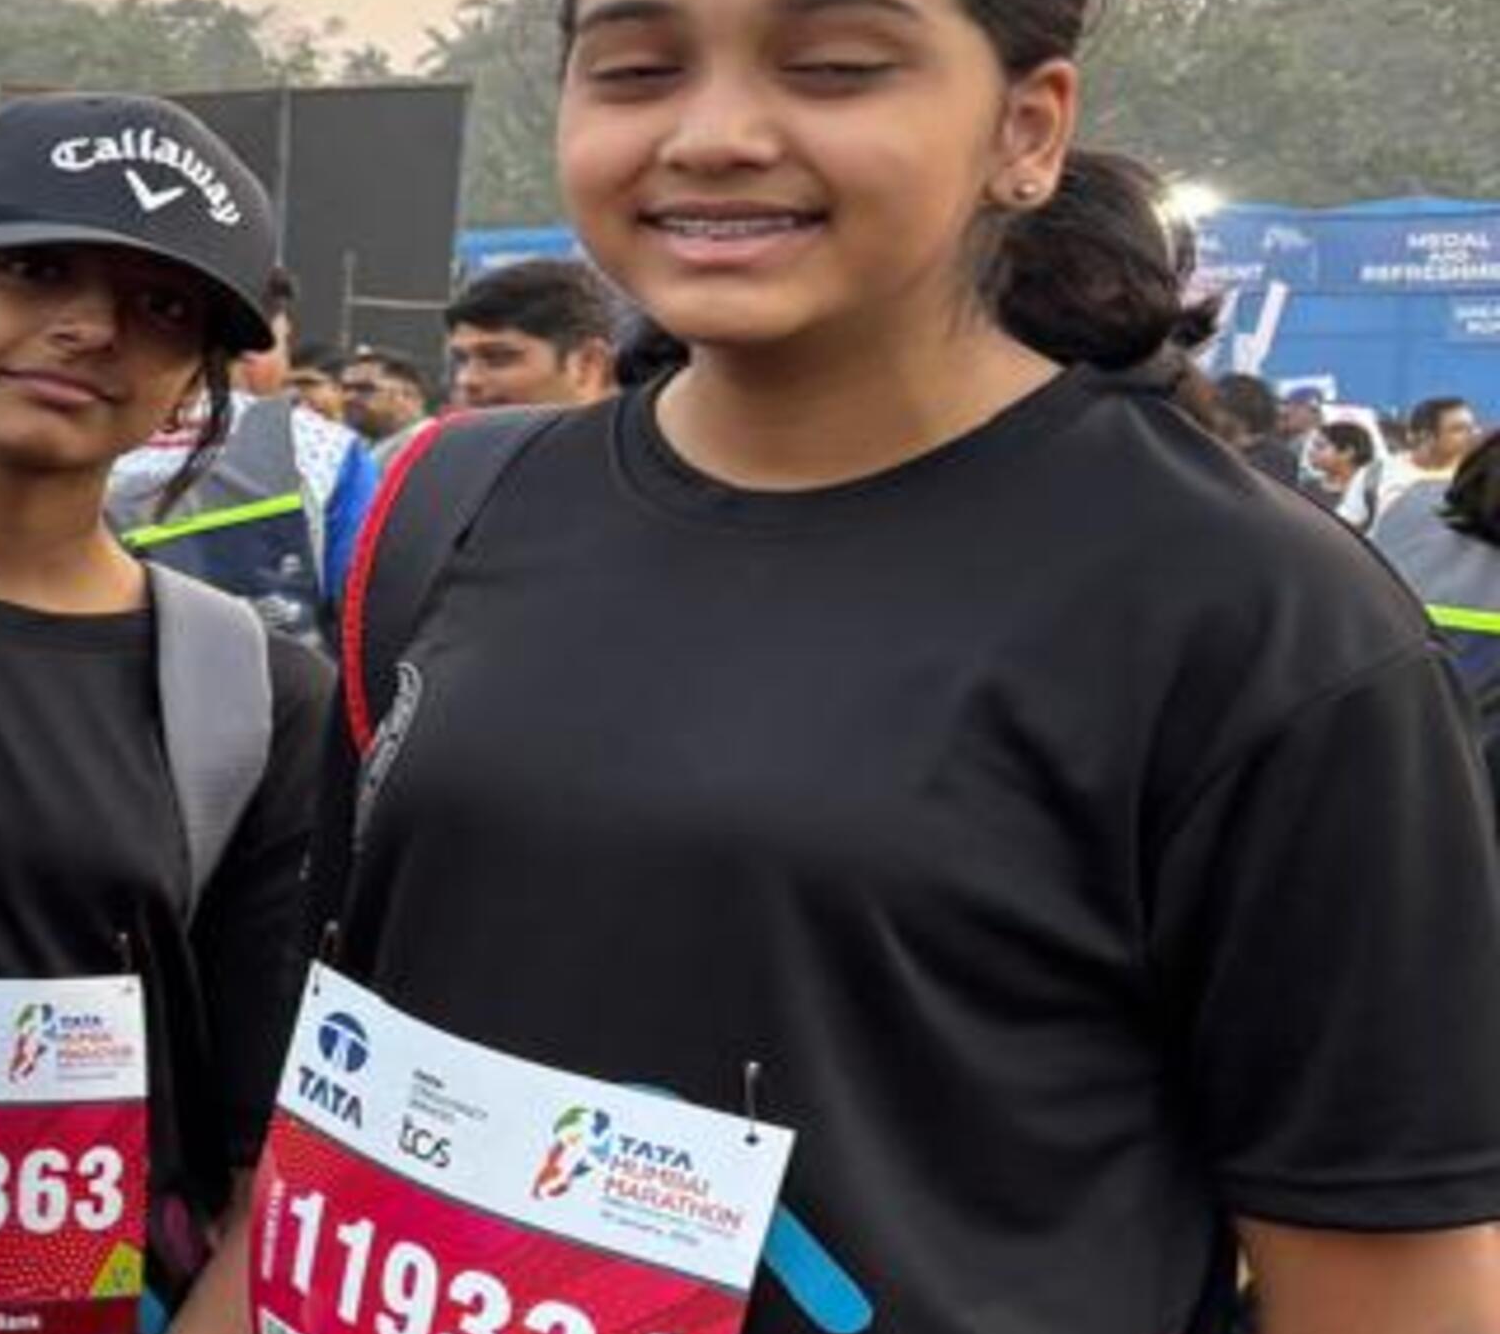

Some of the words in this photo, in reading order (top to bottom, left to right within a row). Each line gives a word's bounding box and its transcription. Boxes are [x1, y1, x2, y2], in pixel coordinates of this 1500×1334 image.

[51, 128, 241, 226] Callaway
[299, 1066, 364, 1131] TATA
[397, 1113, 452, 1169] tcs
[617, 1134, 694, 1171] TATA
[603, 1175, 745, 1230] MARATHON
